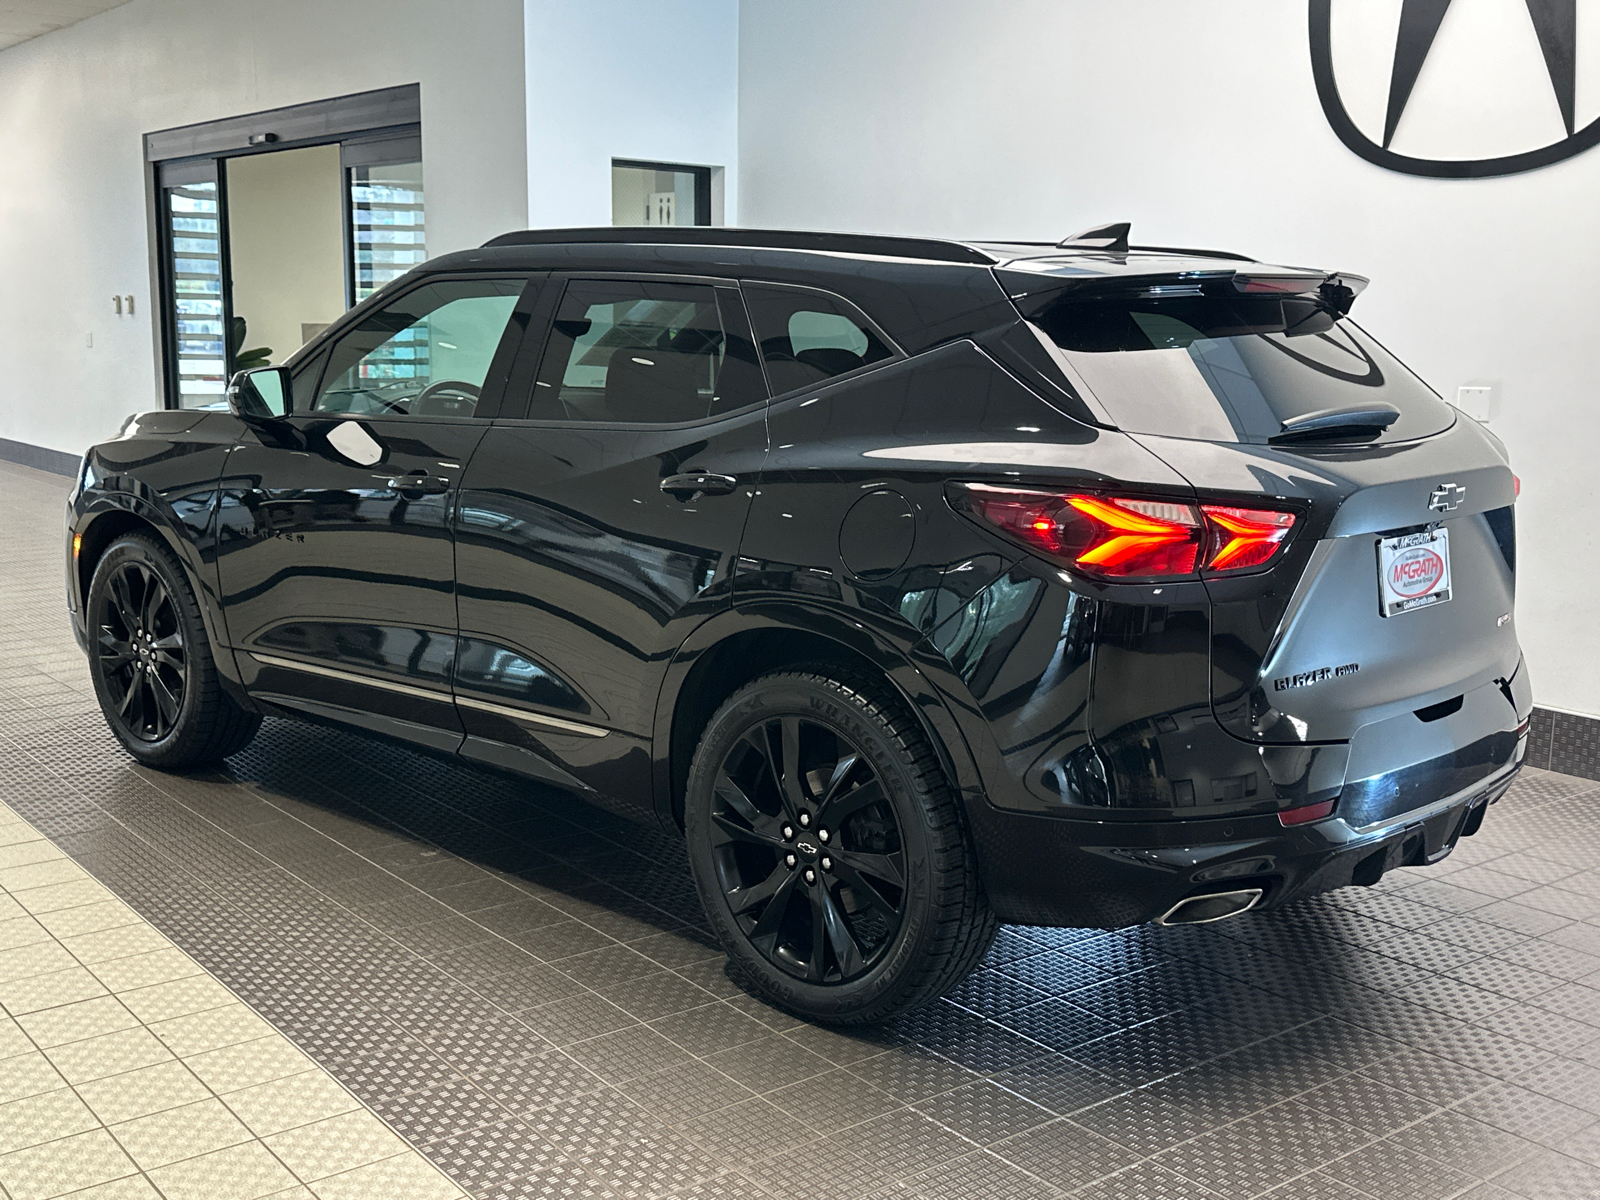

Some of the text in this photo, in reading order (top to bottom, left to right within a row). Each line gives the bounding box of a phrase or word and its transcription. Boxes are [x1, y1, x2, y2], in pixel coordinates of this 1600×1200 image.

[1403, 595, 1437, 609] GoMcGrath.com
[1273, 662, 1360, 691] BLAZER AWD
[808, 695, 902, 793] WRANGLER
